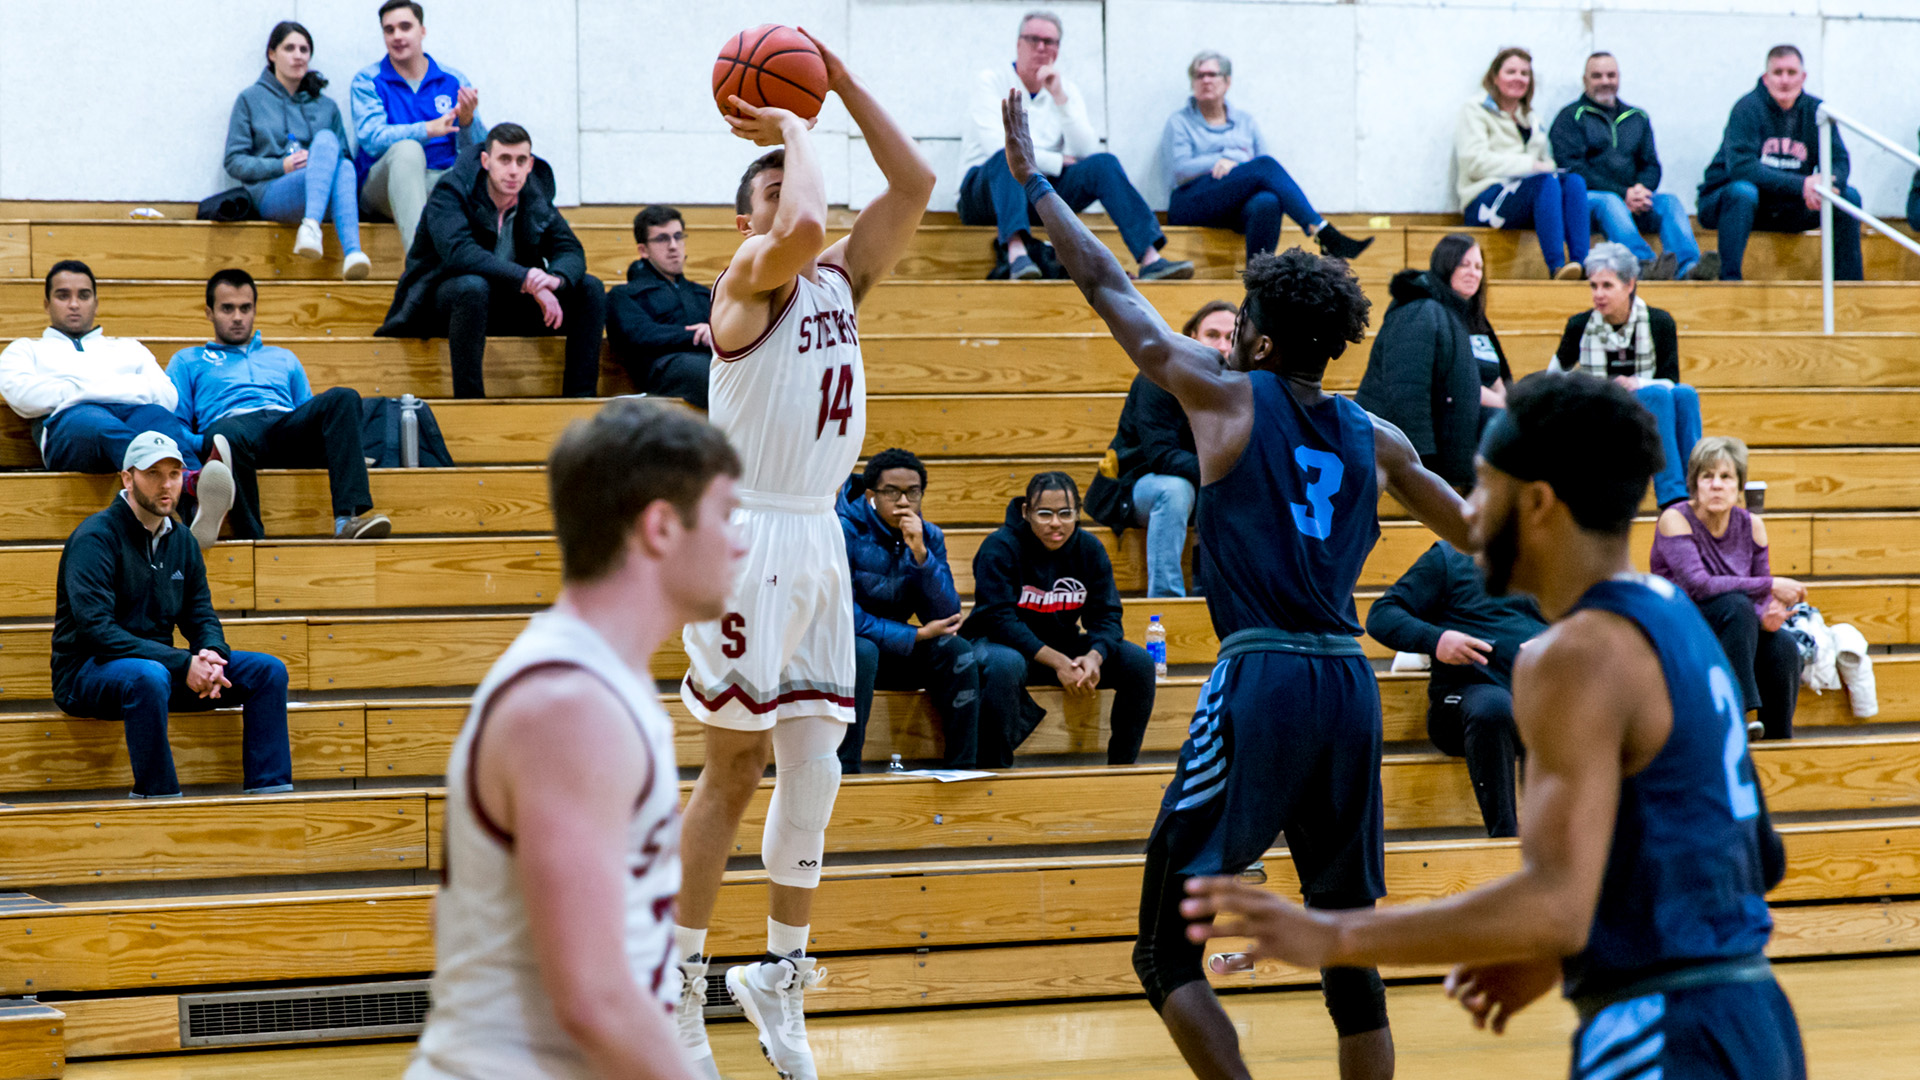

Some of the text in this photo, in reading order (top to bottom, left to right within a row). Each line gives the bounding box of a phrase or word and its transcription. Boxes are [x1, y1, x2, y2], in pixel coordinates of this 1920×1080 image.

[815, 363, 854, 441] 14
[1289, 444, 1345, 541] 3
[721, 611, 747, 660] S
